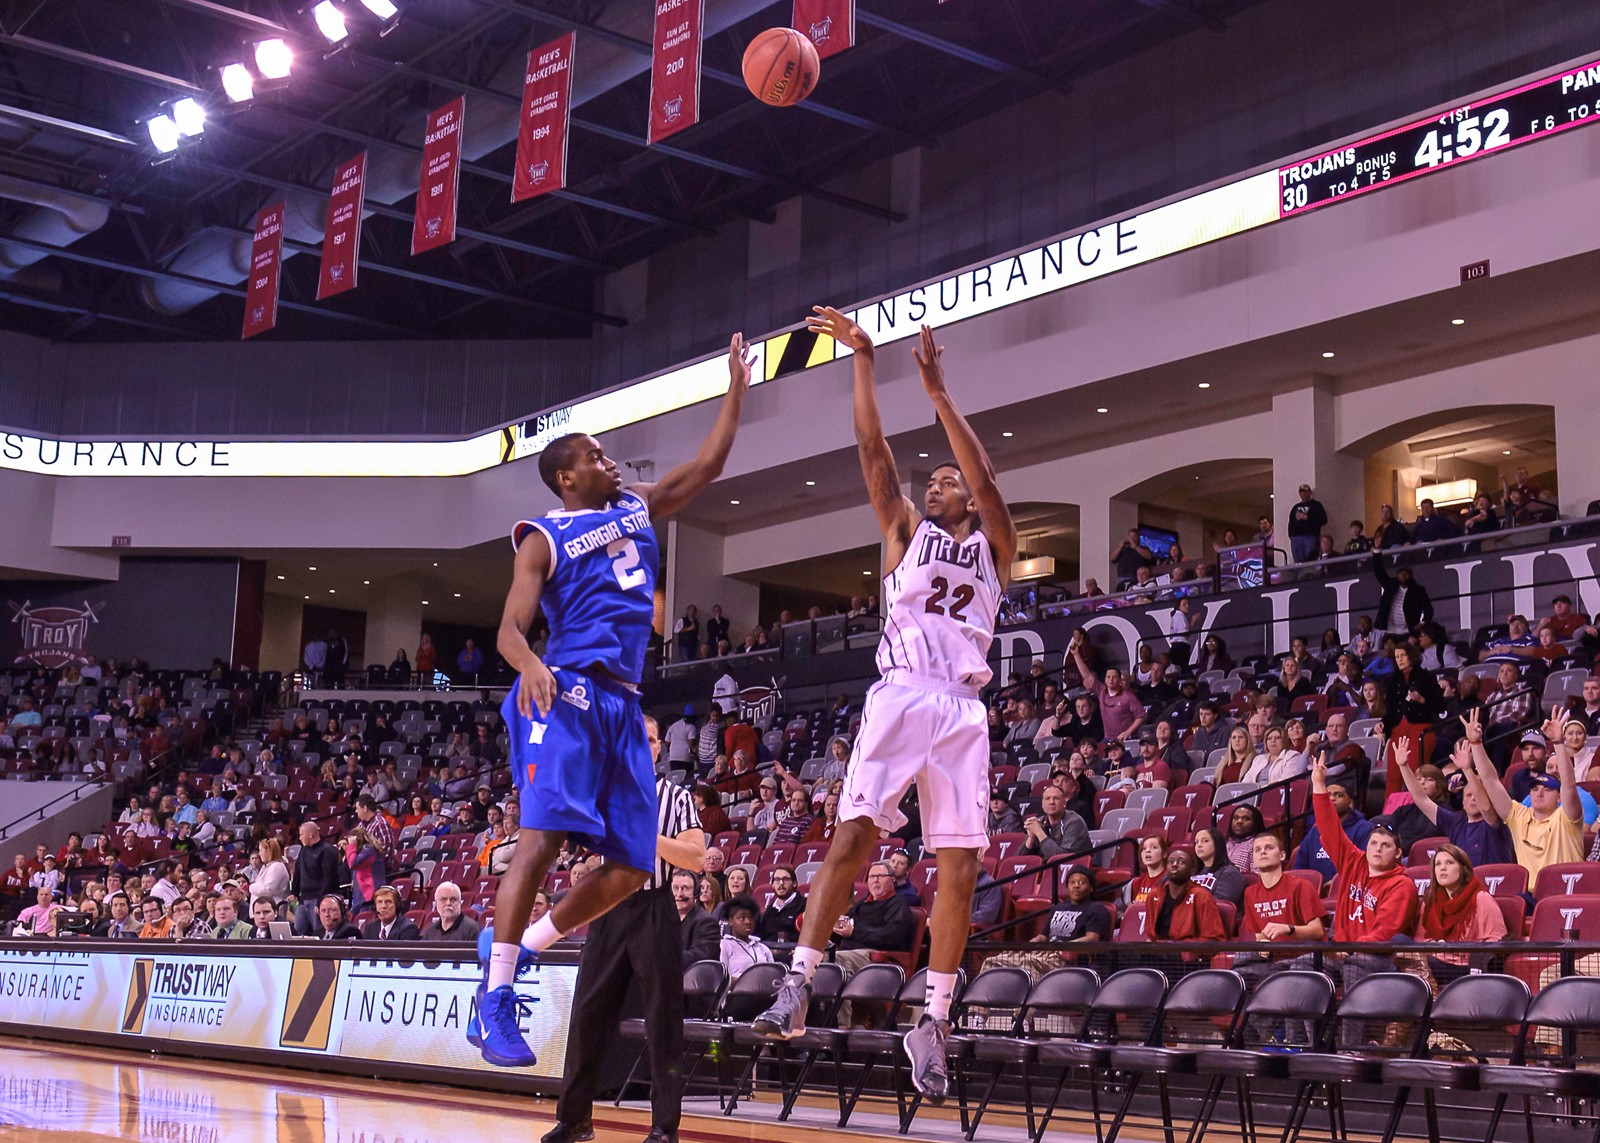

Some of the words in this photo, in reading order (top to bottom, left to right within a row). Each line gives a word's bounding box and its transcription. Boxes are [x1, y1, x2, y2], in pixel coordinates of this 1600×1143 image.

[662, 31, 691, 51] CHAMPIONS
[666, 29, 678, 39] SUN
[525, 58, 568, 84] BASKETBALL
[666, 57, 684, 76] 2010
[767, 60, 795, 102] Wilson
[1562, 65, 1600, 94] PAN
[532, 125, 550, 140] 1994
[1531, 119, 1539, 134] F
[1545, 115, 1555, 130] 6
[1568, 104, 1589, 121] TO
[1414, 108, 1510, 168] 4:52
[1280, 148, 1355, 187] TROJANS
[1356, 151, 1397, 175] BONUS
[1329, 182, 1347, 197] TO
[1350, 176, 1359, 190] 4
[1370, 172, 1377, 185] F
[1382, 166, 1391, 181] 5
[1283, 184, 1308, 212] 30
[1466, 266, 1485, 278] 103
[517, 406, 573, 439] TSTWAY
[4, 433, 231, 466] SURANCE
[564, 520, 622, 559] GEORGIA
[607, 538, 647, 591] 2
[925, 576, 975, 623] 22
[31, 624, 78, 647] TROY
[29, 650, 76, 660] TROJANS
[1349, 905, 1364, 923] A
[155, 963, 236, 997] TRUSTWAY
[149, 1004, 225, 1026] INSURANCE
[344, 990, 540, 1033] INSURAE
